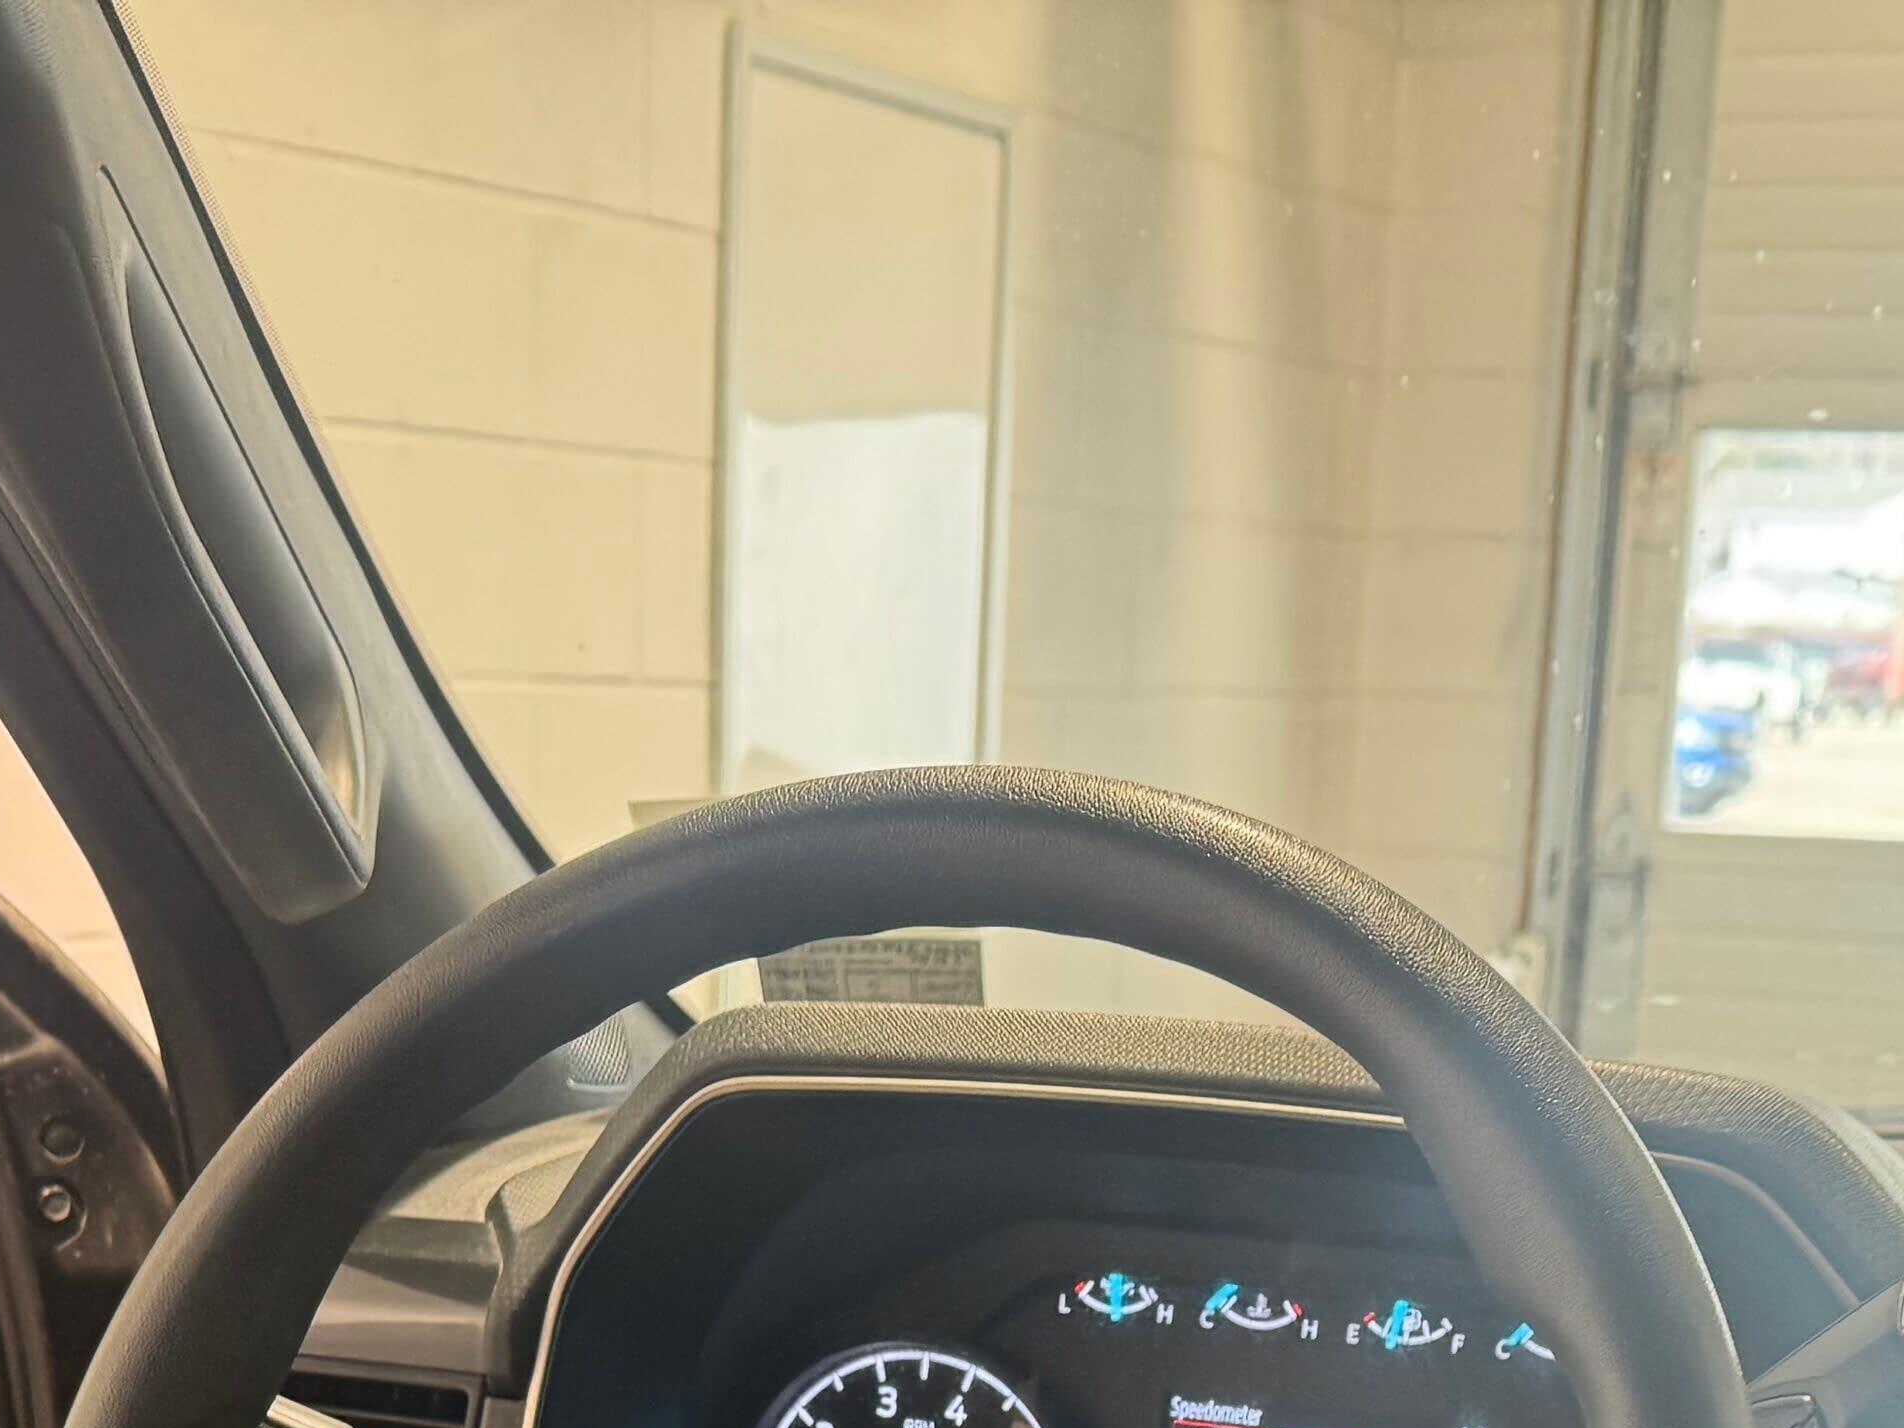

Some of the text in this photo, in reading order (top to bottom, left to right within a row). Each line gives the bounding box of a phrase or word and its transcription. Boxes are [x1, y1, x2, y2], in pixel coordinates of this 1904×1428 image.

[1058, 1293, 1071, 1314] L
[1156, 1304, 1174, 1325] H
[1199, 1310, 1215, 1329] C
[1301, 1319, 1320, 1341] H
[1346, 1323, 1361, 1345] E
[1451, 1333, 1466, 1355] F
[1495, 1338, 1511, 1361] C
[875, 1386, 898, 1418] 3
[944, 1395, 967, 1427] 4
[1169, 1395, 1263, 1426] Speedometer
